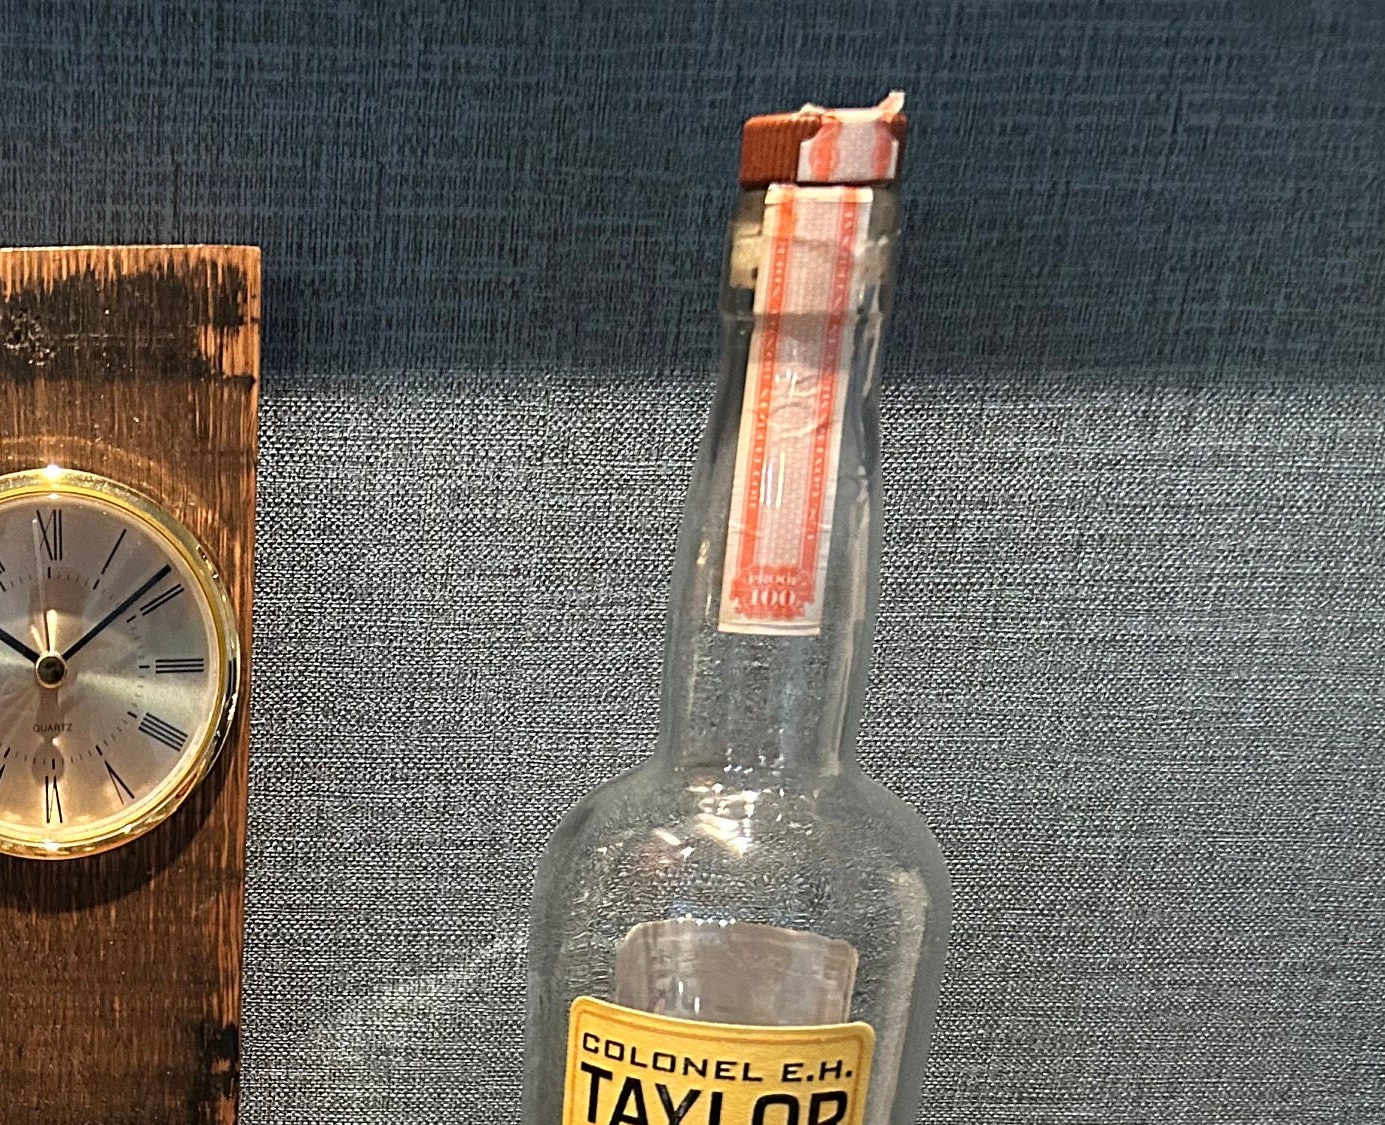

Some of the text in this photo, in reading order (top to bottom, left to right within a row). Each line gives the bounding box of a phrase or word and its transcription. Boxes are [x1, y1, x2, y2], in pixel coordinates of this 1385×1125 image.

[750, 588, 796, 607] 100
[32, 722, 74, 733] QUARTZ
[581, 1031, 854, 1083] COLONEL E.H.
